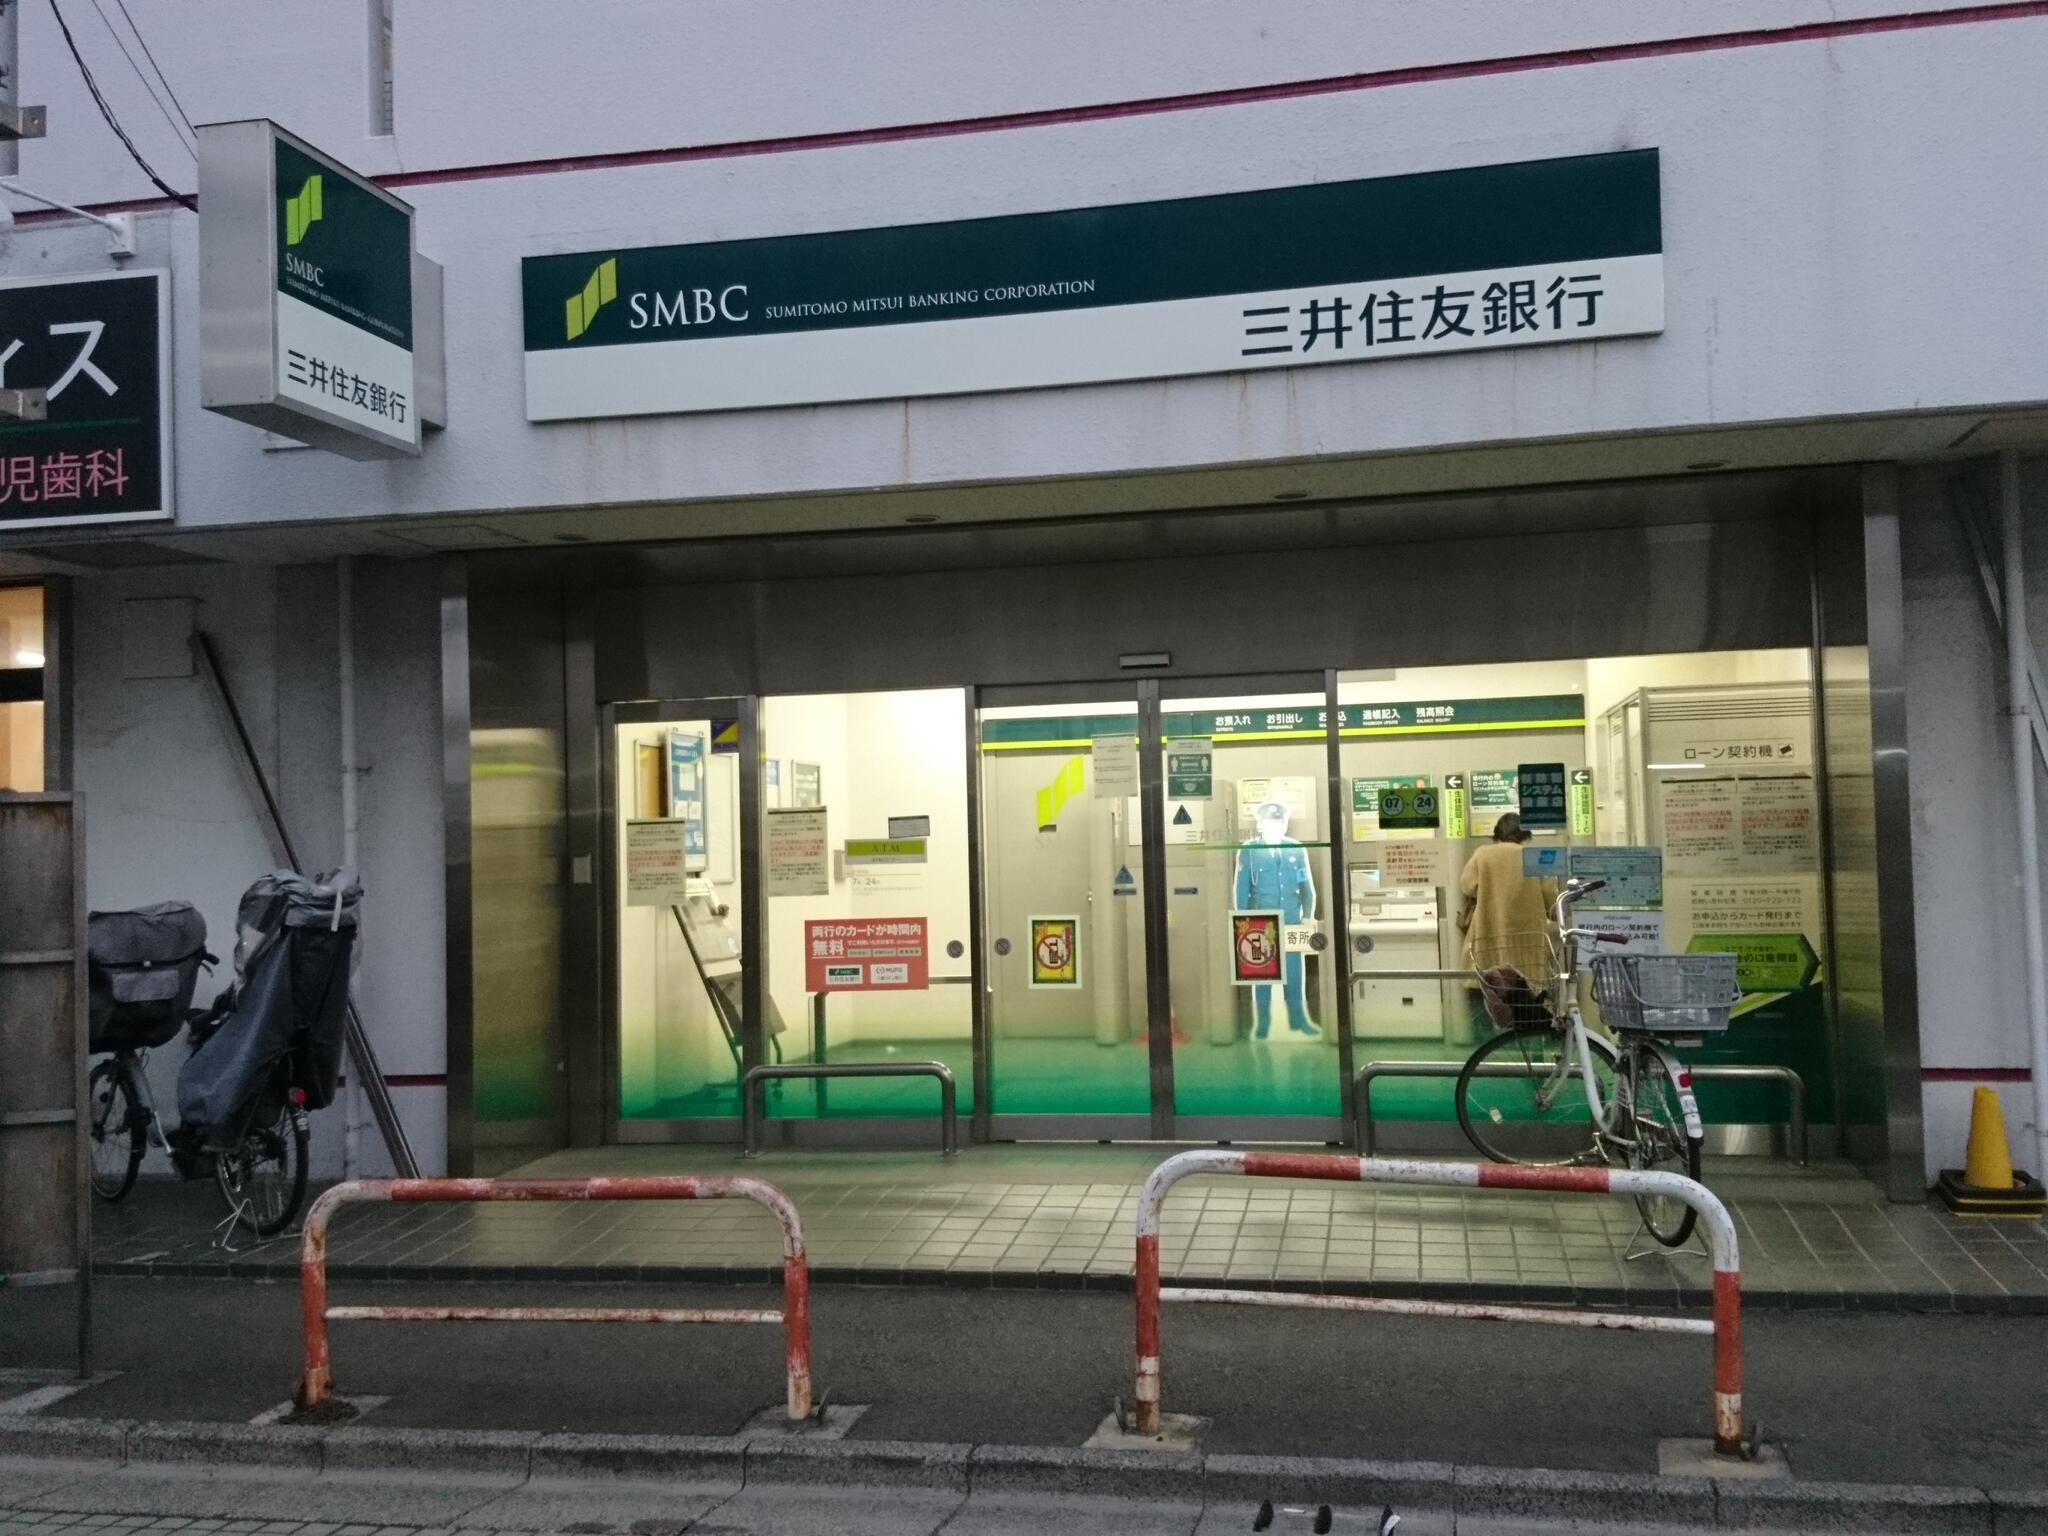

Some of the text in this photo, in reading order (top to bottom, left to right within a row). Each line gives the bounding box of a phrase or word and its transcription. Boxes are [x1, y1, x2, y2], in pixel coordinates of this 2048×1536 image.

[286, 253, 324, 287] SMBC
[630, 279, 1096, 329] SMBC SUMITOMO MITSUI BANKING CORPORATION
[1241, 274, 1604, 356] 三井住友銀行
[288, 349, 406, 423] 三井住友銀行
[0, 448, 130, 503] 児歯科
[1684, 744, 1772, 760] ローン契約機
[1385, 797, 1400, 809] 07
[1417, 797, 1432, 808] 24
[813, 939, 845, 956] 無料
